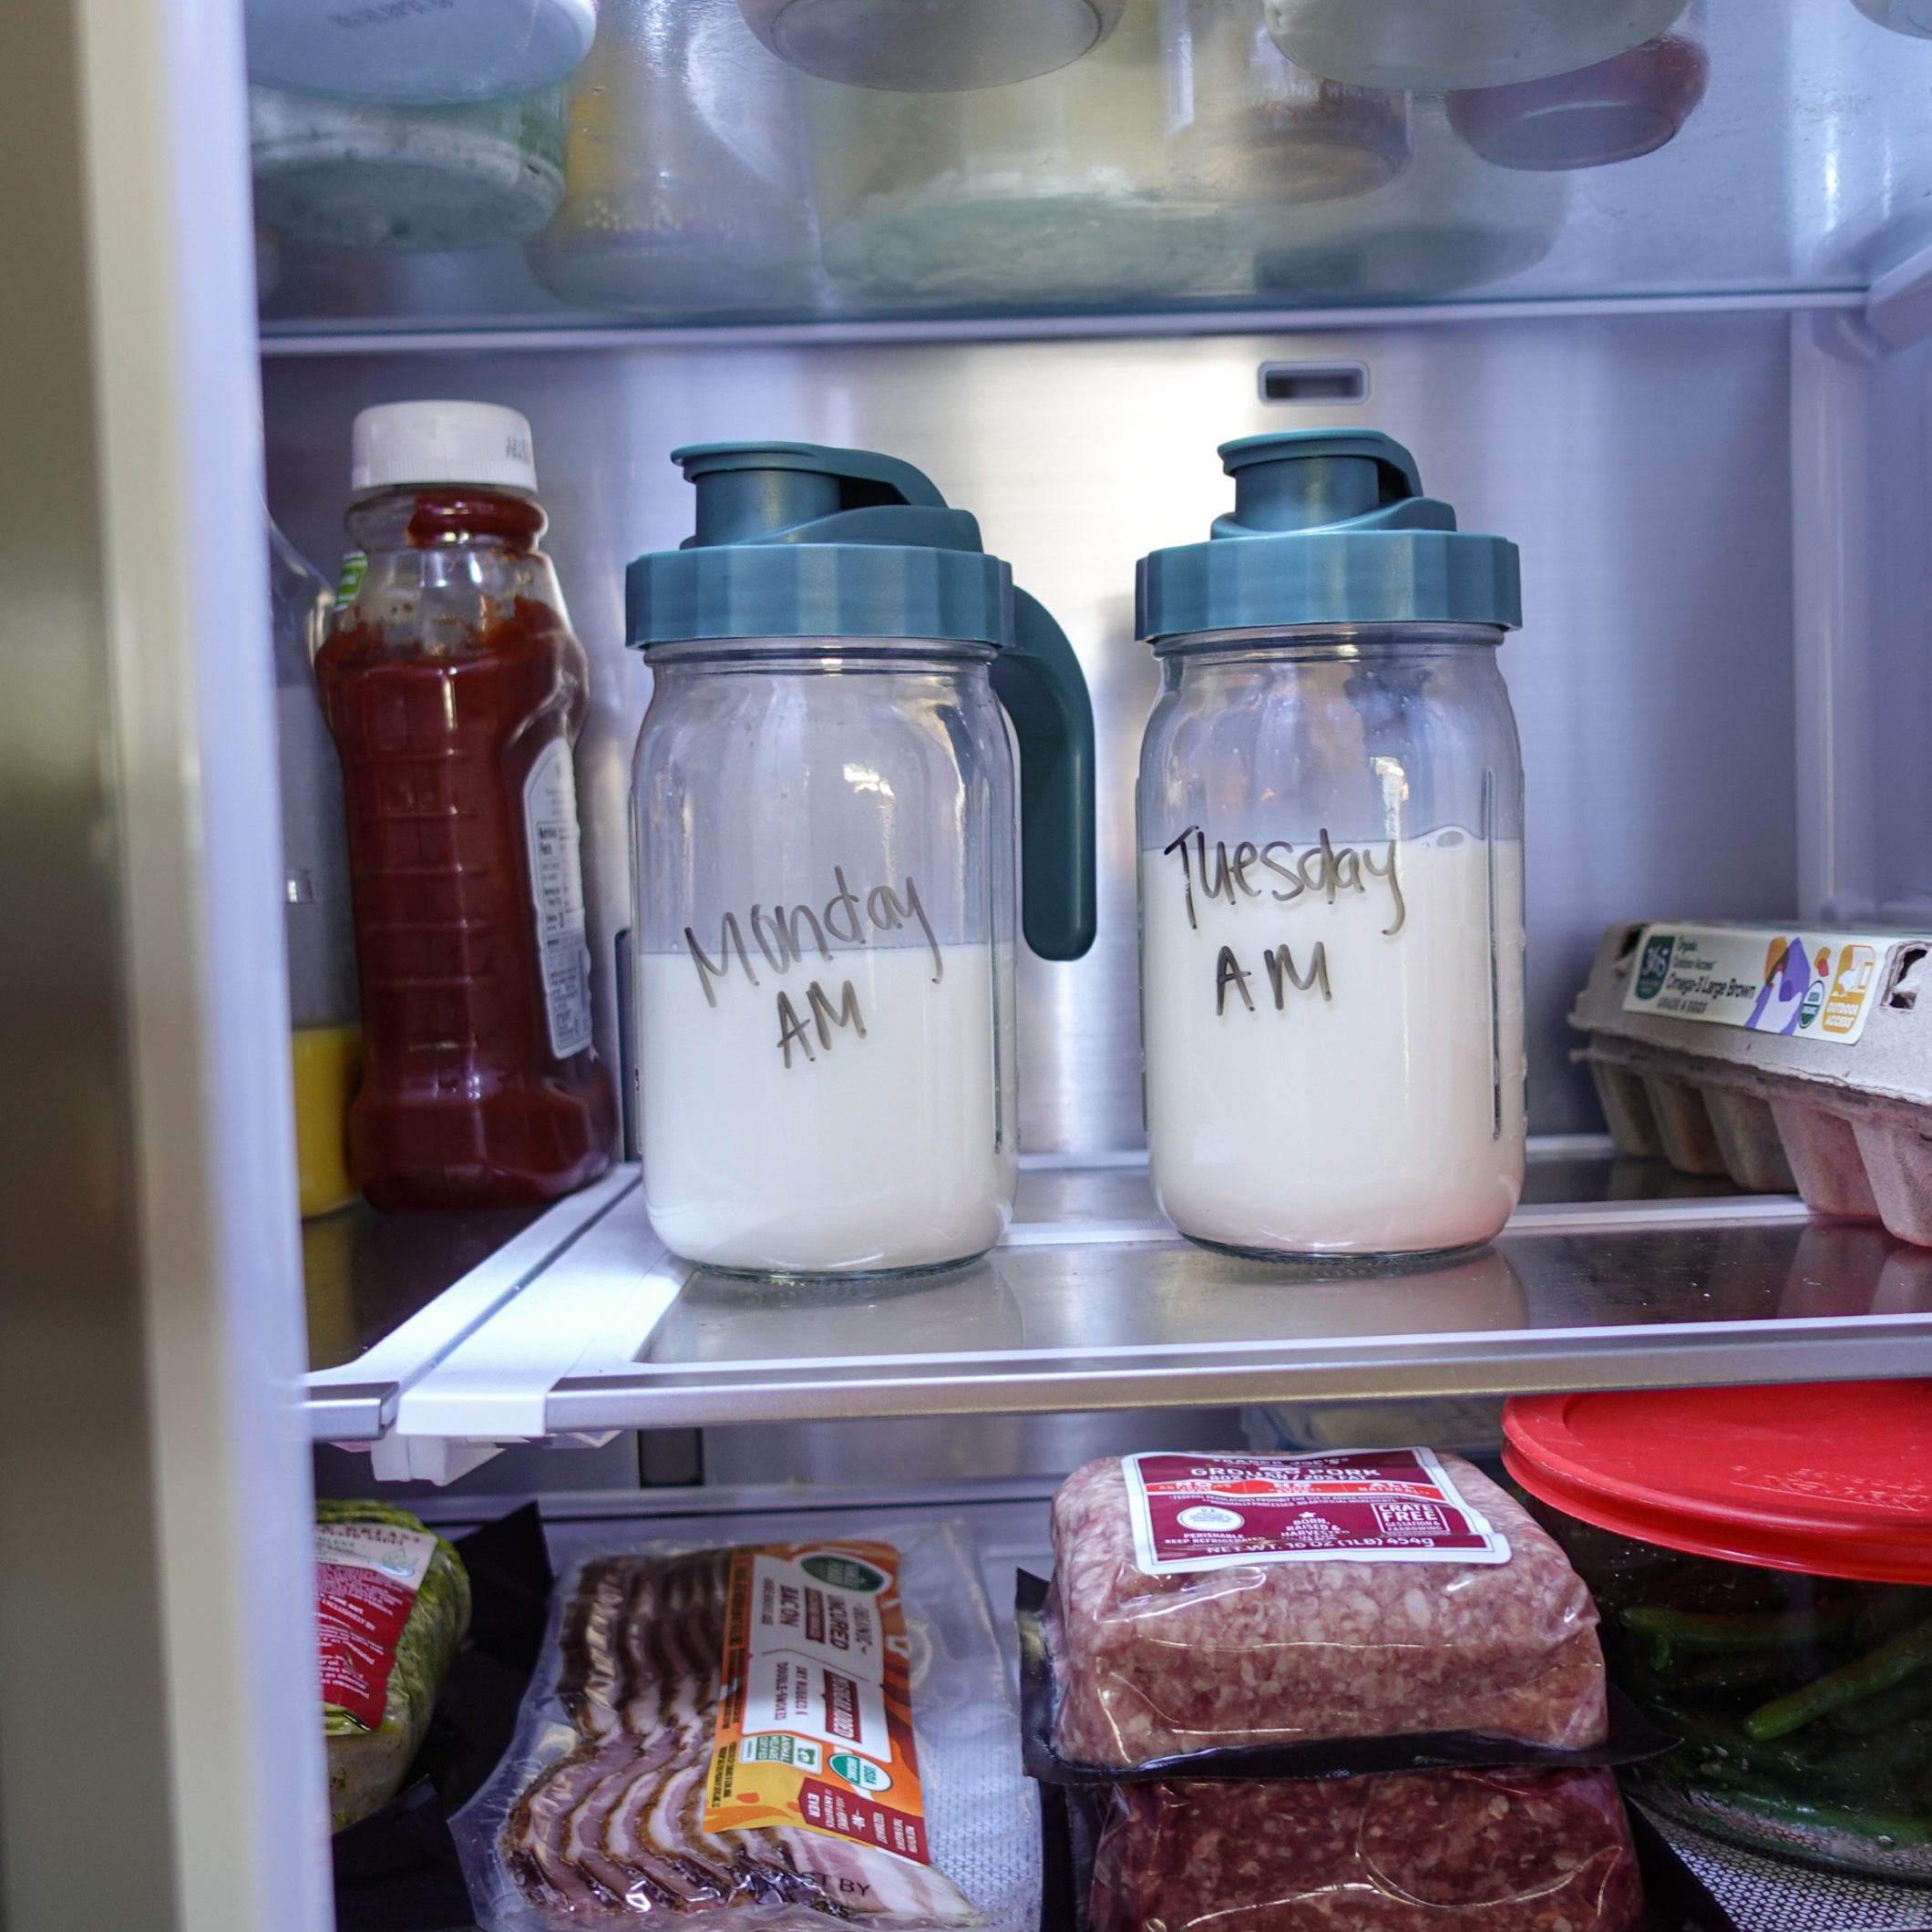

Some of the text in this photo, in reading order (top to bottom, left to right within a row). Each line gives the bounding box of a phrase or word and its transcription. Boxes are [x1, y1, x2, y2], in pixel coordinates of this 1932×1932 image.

[1164, 825, 1406, 936] Tuesday
[683, 865, 944, 1008] Monday
[1216, 940, 1332, 1016] AM
[1701, 976, 1728, 1000] Large
[1726, 978, 1757, 1000] Brown
[1826, 1002, 1860, 1015] OUTDOOR
[776, 980, 868, 1069] AM
[1824, 1014, 1855, 1029] ACCESS
[1190, 1468, 1382, 1477] GROUD PORK
[1378, 1504, 1434, 1512] CRATE
[1382, 1511, 1438, 1521] FREE
[1285, 1523, 1341, 1532] RAISED &
[1292, 1517, 1331, 1526] BORN,
[1207, 1546, 1241, 1554] NET
[1246, 1543, 1283, 1551] WT.
[1338, 1536, 1384, 1547] (1LB)
[1386, 1536, 1435, 1547] 454g
[779, 1584, 800, 1628] BACON
[827, 1593, 850, 1650] UNCURED
[833, 1707, 854, 1739] ADDED
[779, 1736, 792, 1762] ANIMAL
[846, 1756, 858, 1784] ORGANIC
[863, 1765, 877, 1785] USDA
[807, 1793, 821, 1818] EVER
[824, 1794, 835, 1829] ANTIBIOTICS
[839, 1878, 872, 1896] BY
